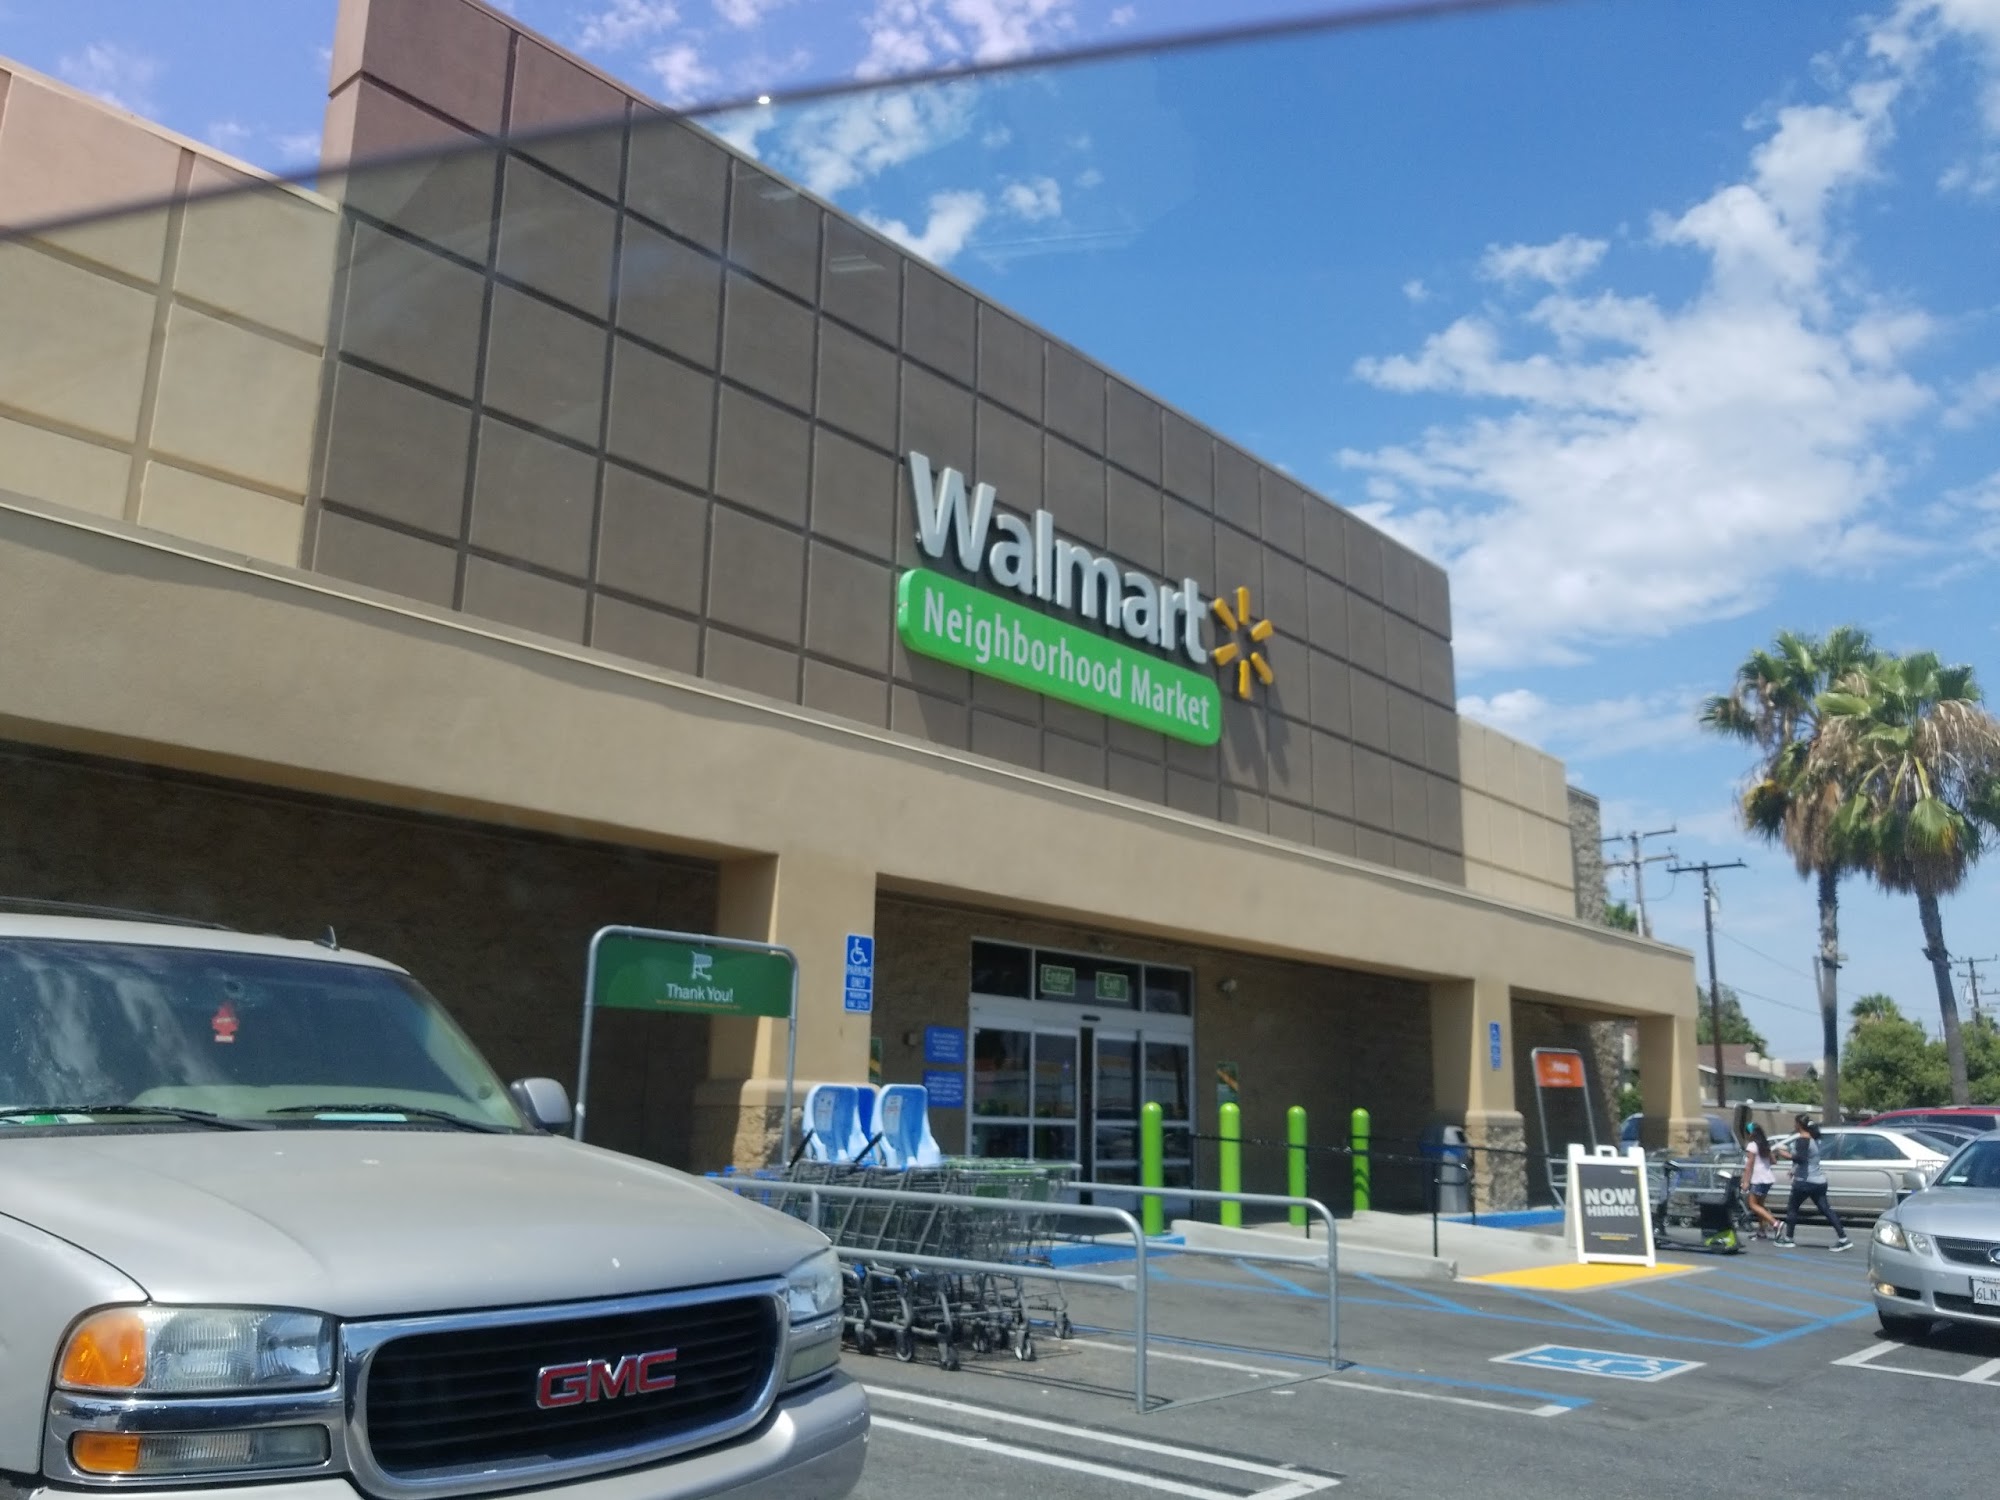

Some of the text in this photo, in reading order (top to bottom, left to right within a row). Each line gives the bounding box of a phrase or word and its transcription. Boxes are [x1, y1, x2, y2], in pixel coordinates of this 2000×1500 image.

[909, 451, 1207, 664] Walmart
[923, 587, 1210, 730] Neighborhood Market
[666, 983, 734, 1002] Thank You!
[1583, 1188, 1636, 1206] NOW
[1586, 1205, 1640, 1217] HIRING!
[1975, 1287, 2000, 1301] 6LN
[536, 1348, 678, 1409] GMC
